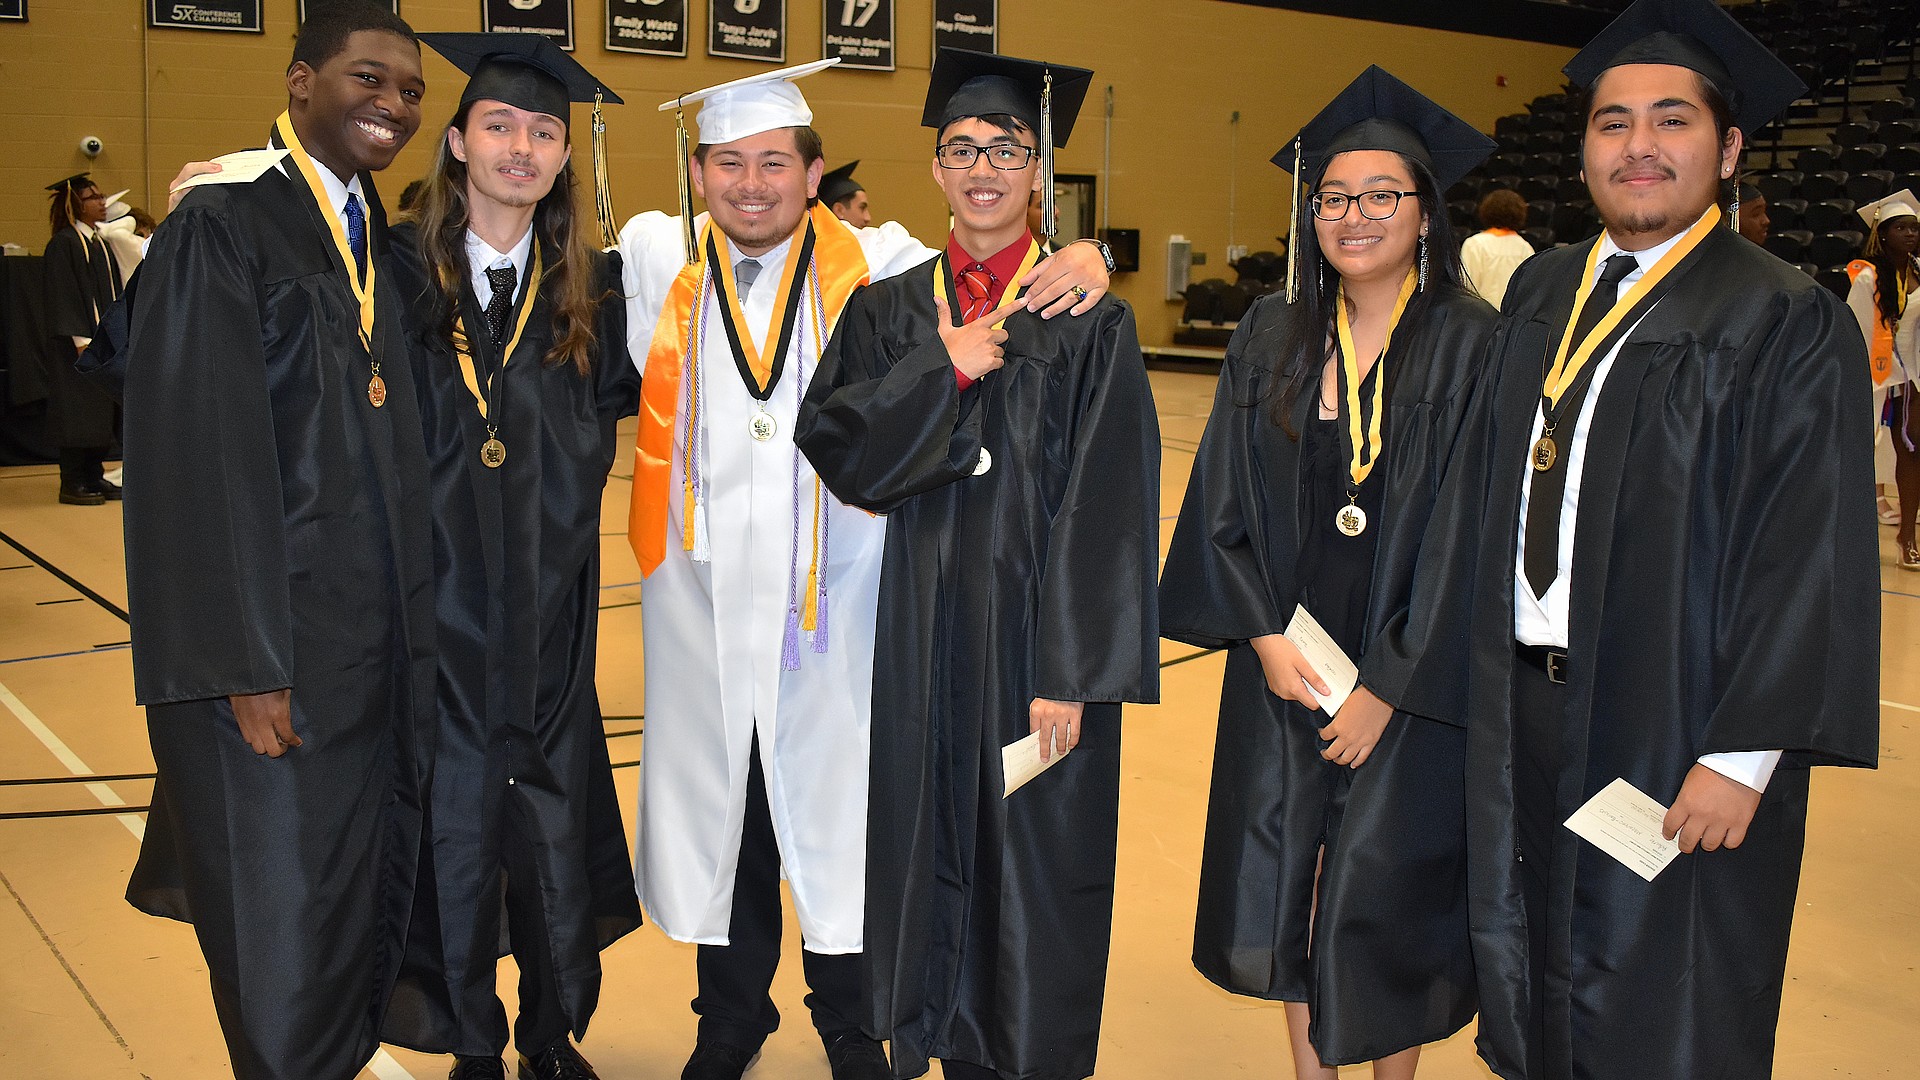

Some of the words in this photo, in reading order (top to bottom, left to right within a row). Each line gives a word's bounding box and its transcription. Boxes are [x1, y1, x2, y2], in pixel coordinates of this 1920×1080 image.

[171, 4, 196, 21] 5X
[193, 9, 242, 19] CONFERENCE
[193, 15, 242, 24] CHAMPIONS
[613, 15, 645, 30] Emily
[645, 18, 679, 32] Watts
